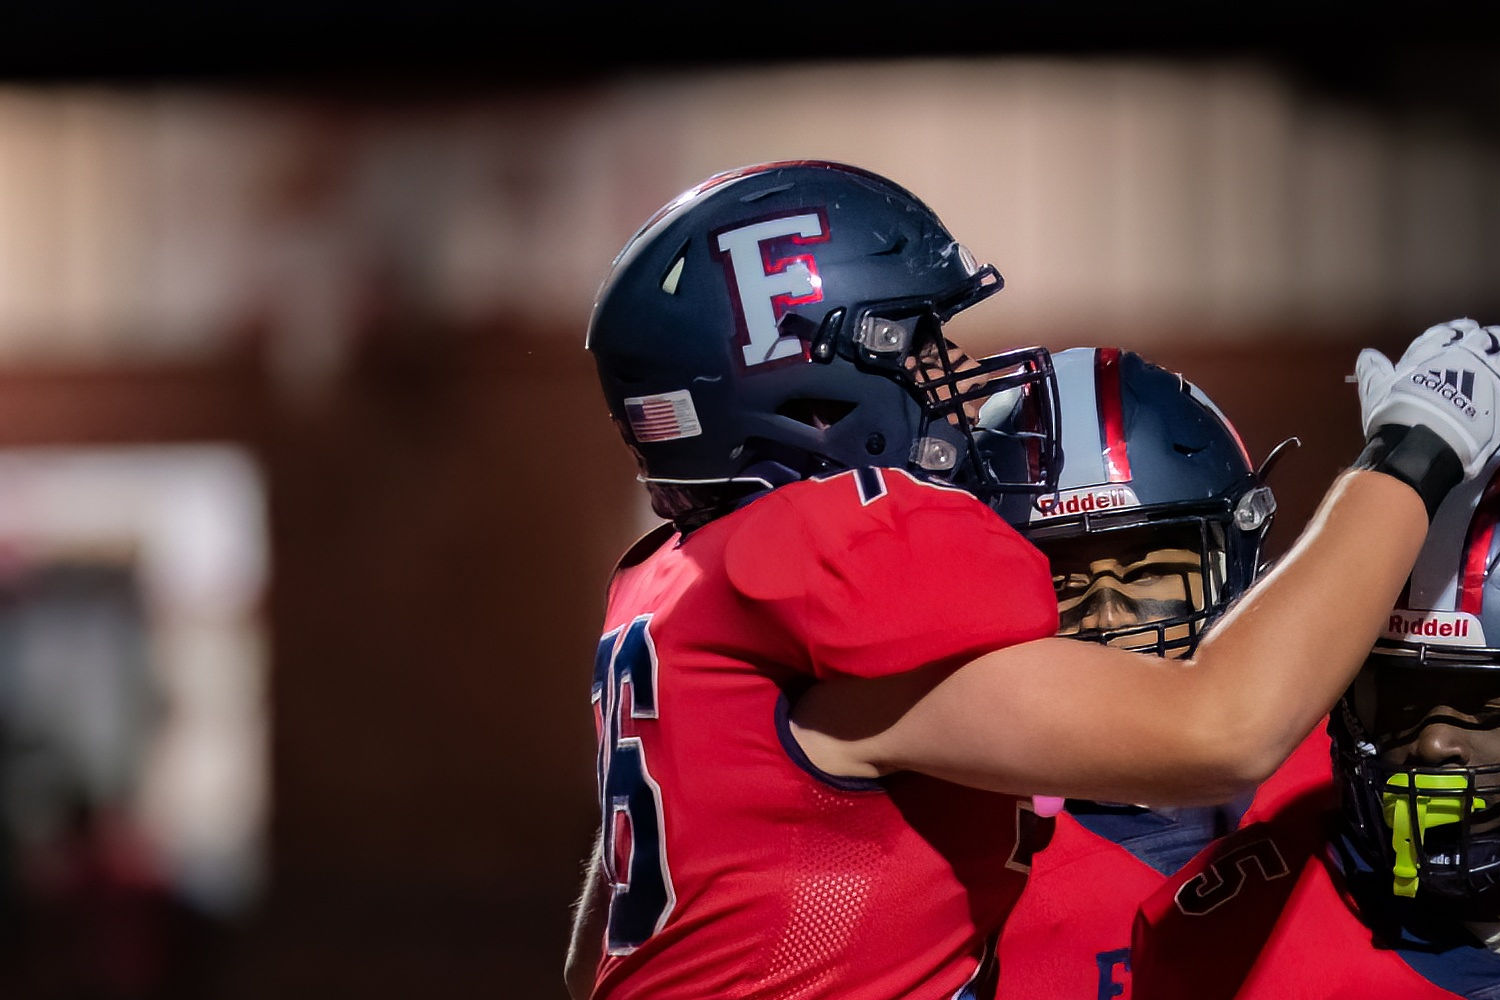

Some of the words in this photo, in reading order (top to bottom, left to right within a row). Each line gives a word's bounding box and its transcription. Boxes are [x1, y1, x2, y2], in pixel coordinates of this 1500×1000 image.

[711, 208, 830, 376] F
[1413, 374, 1477, 417] adidas
[1041, 488, 1126, 517] Riddell
[1388, 614, 1469, 637] Riddell
[591, 613, 677, 955] 76
[1175, 838, 1290, 916] 5
